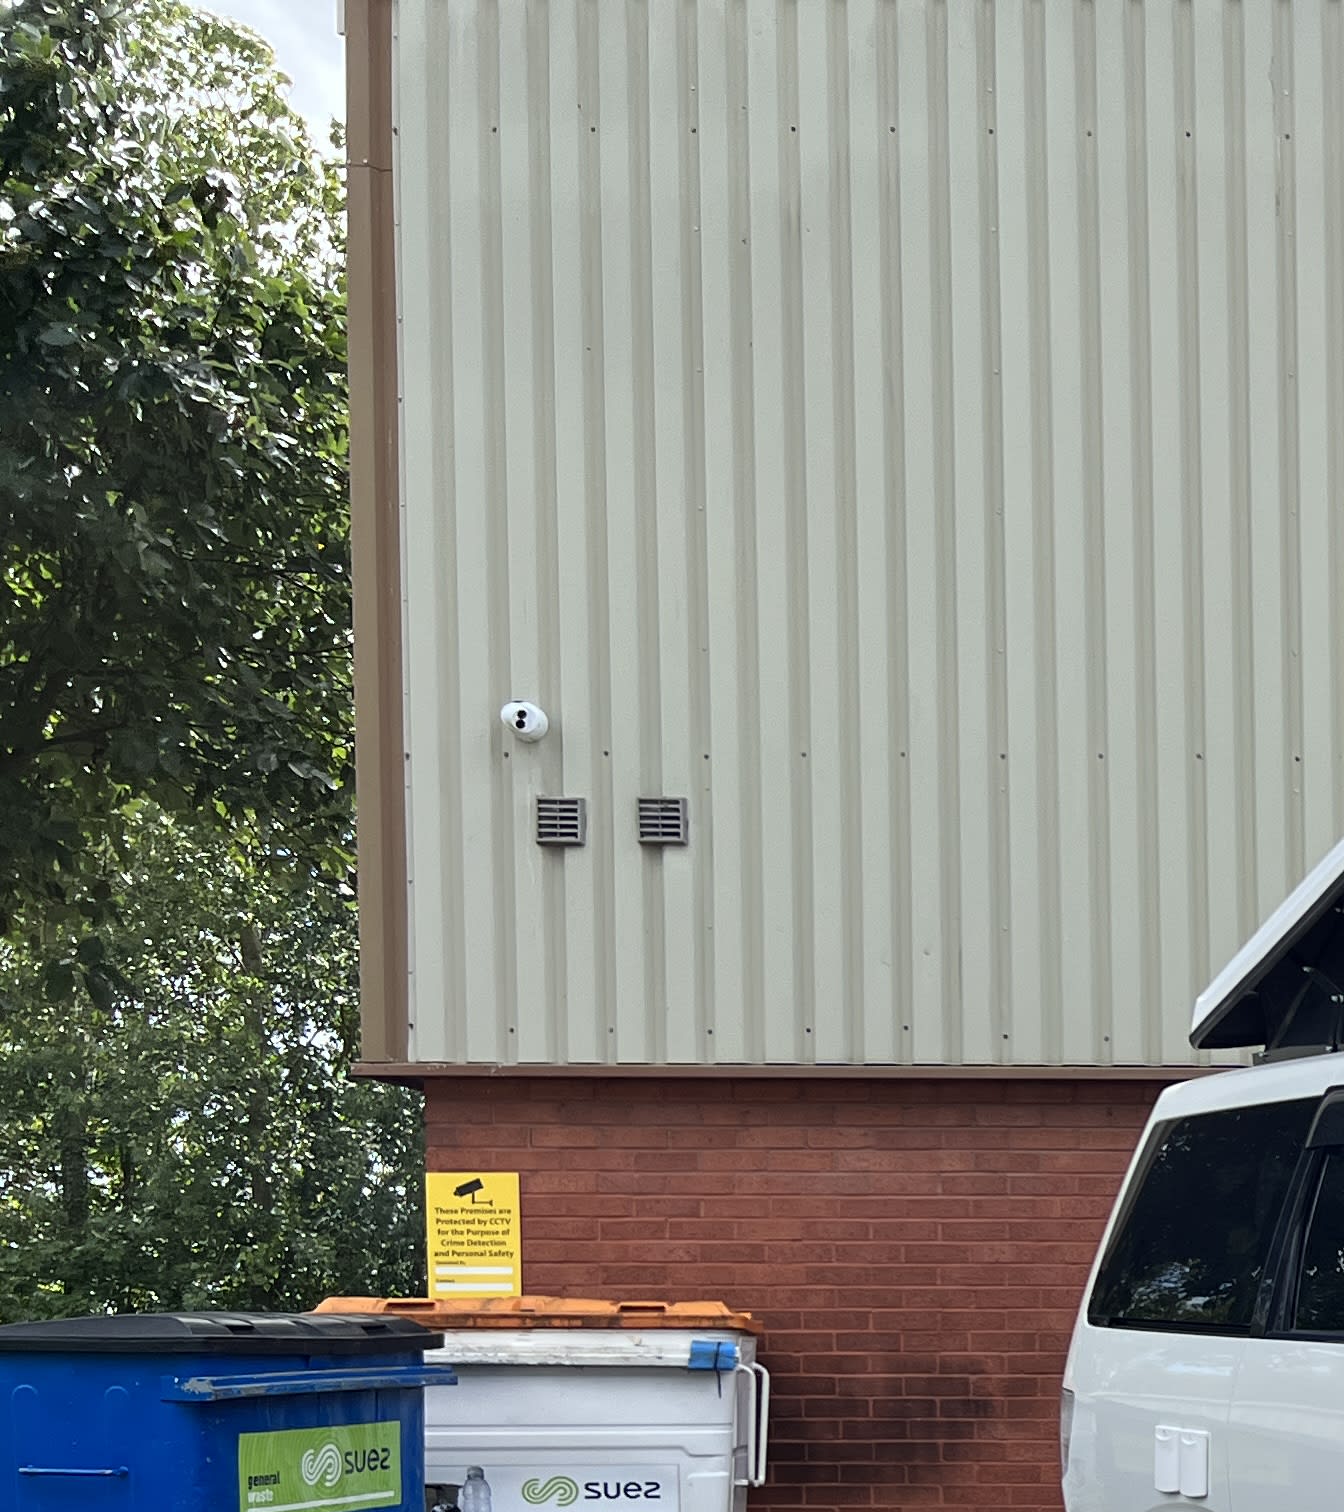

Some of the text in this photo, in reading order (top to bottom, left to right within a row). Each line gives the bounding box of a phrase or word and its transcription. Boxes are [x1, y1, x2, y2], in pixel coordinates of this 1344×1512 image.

[477, 1218, 487, 1226] by
[466, 1229, 500, 1237] Purpose
[440, 1239, 507, 1247] Crime Detection
[488, 1250, 514, 1259] Safety
[344, 1447, 391, 1475] suez
[247, 1470, 281, 1490] general
[247, 1488, 274, 1504] waste
[584, 1481, 661, 1500] suez
